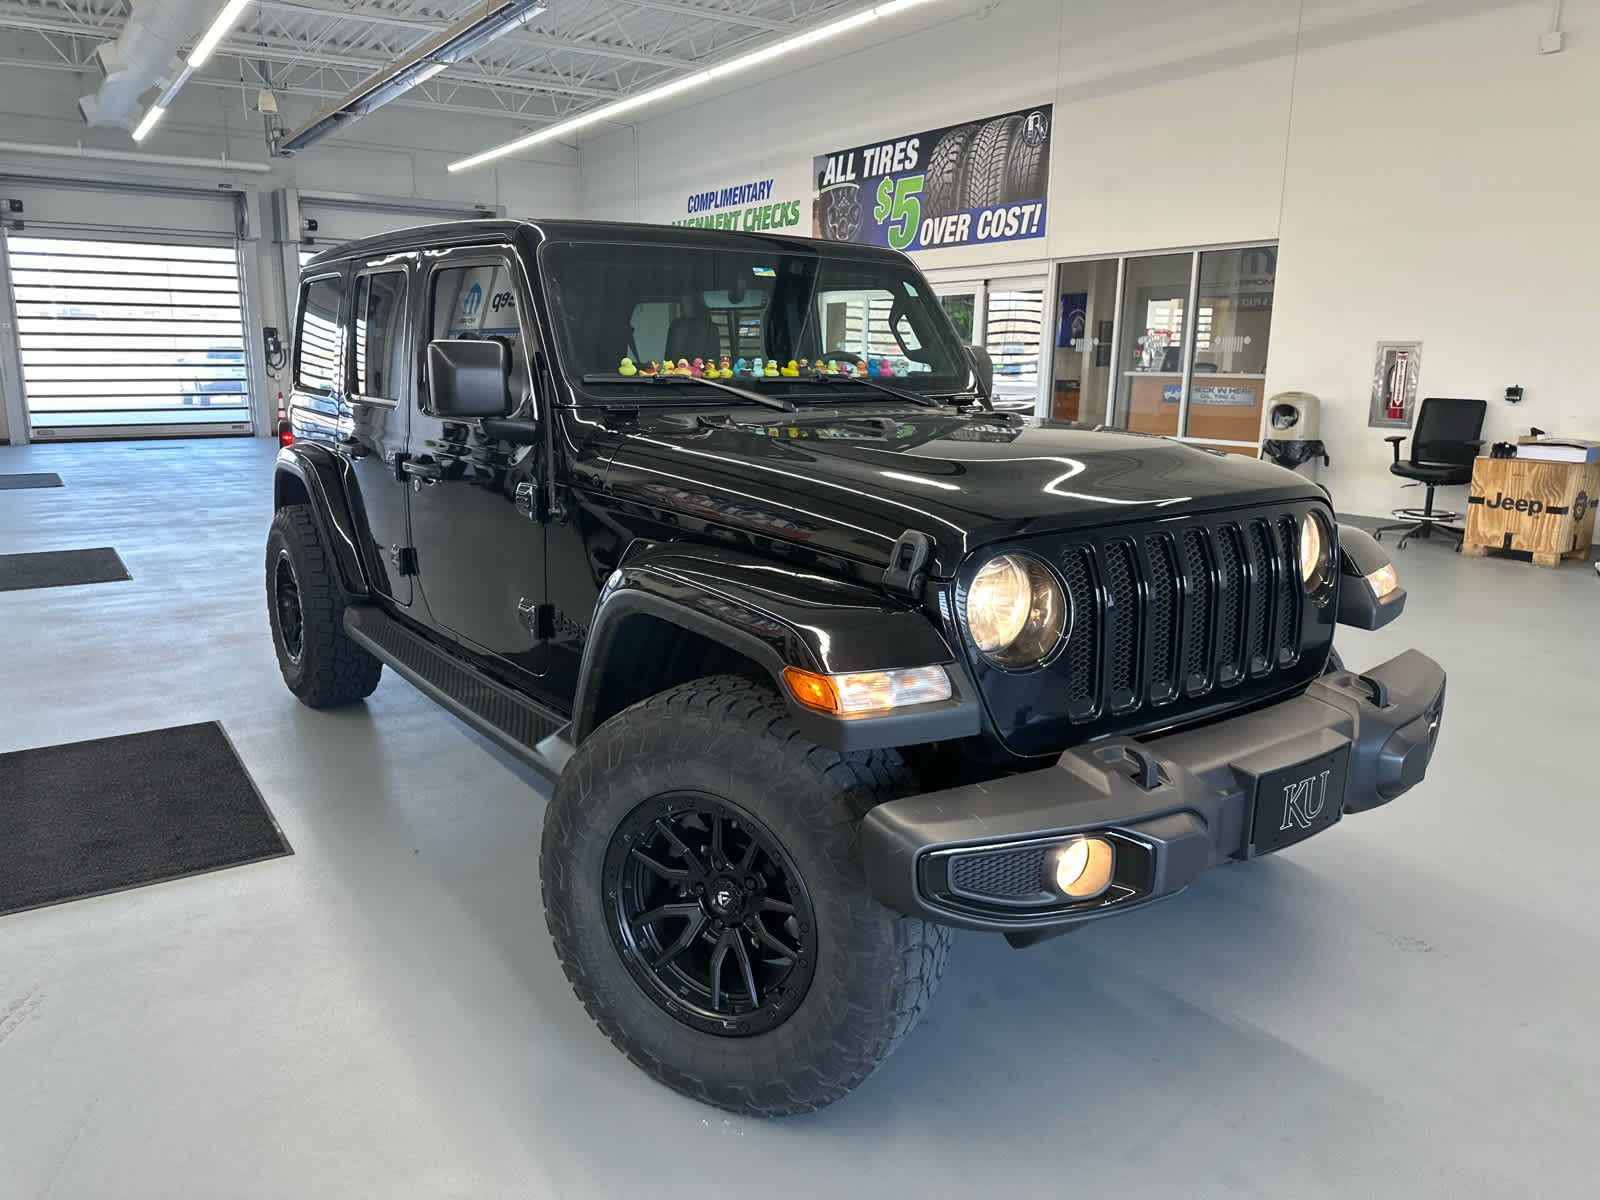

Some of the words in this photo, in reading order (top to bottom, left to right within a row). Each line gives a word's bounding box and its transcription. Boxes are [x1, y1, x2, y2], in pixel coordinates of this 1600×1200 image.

[823, 152, 856, 186] ALL
[863, 138, 920, 178] TIRES
[672, 210, 742, 231] GNMENT
[743, 200, 800, 232] CHECKS
[687, 179, 774, 213] COMPLIMENTARY
[874, 174, 924, 249] $5
[920, 213, 971, 246] OVER
[977, 203, 1042, 240] COST!
[1487, 492, 1543, 516] Jeep
[1280, 770, 1330, 830] KU
